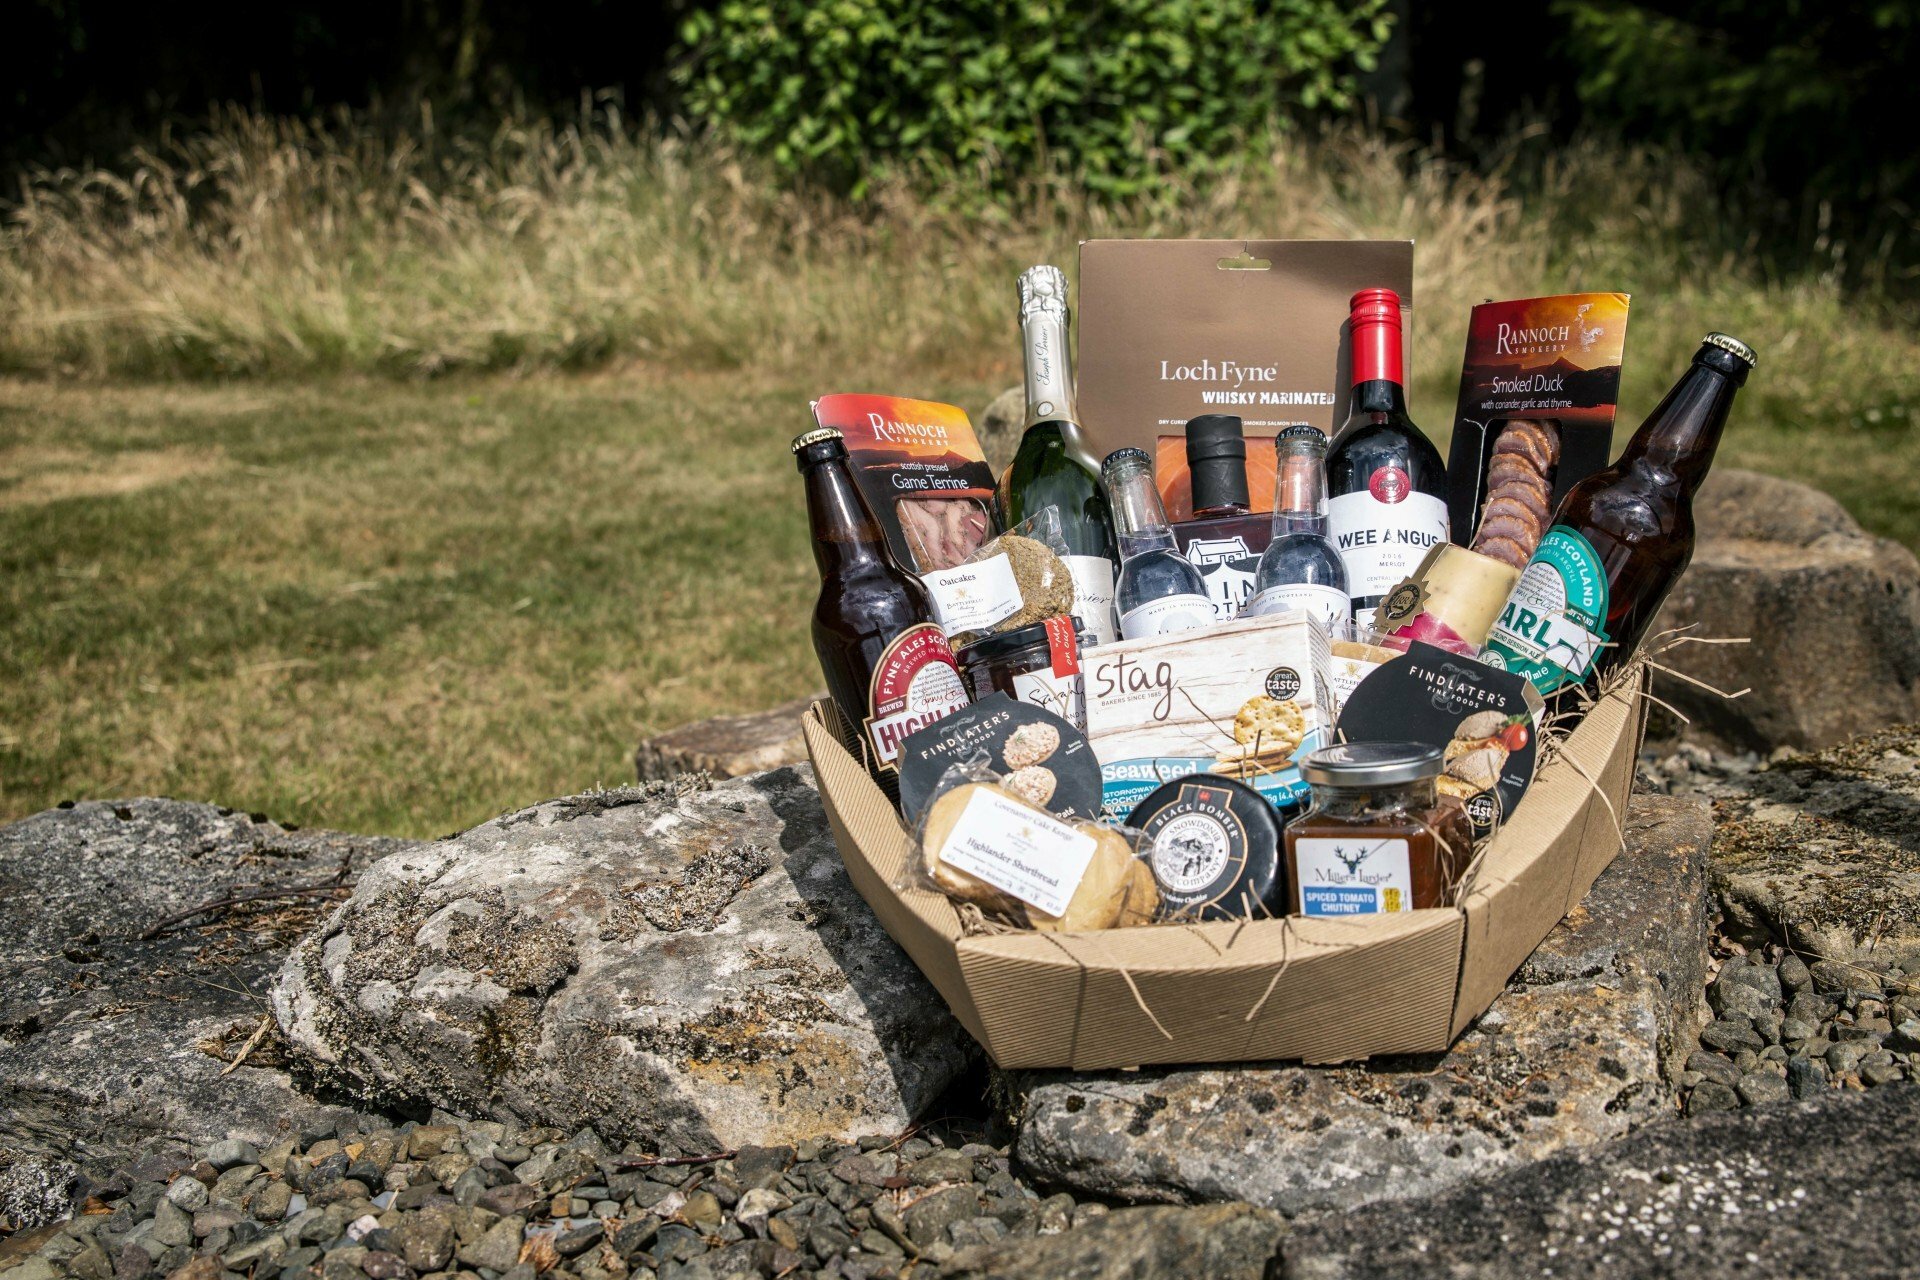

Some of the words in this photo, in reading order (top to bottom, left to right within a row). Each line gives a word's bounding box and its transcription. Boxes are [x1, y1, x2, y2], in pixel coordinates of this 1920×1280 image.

[1496, 323, 1570, 354] RANNOCH
[1515, 344, 1566, 354] SMOKERY
[1160, 360, 1218, 380] Loch
[1220, 361, 1278, 388] Fyne
[1492, 375, 1532, 394] Smoked
[1534, 374, 1564, 392] Duck
[1202, 392, 1256, 405] WHISKY
[1260, 392, 1336, 405] MARINATED
[1481, 400, 1494, 409] with
[1520, 398, 1536, 411] garlic
[1537, 398, 1550, 408] and
[1550, 398, 1572, 411] thyme
[867, 413, 948, 442] RANNOCH
[896, 436, 949, 446] SMOKERY
[900, 462, 924, 470] scottish
[925, 463, 949, 472] pressed
[892, 474, 928, 489] Game
[926, 474, 969, 490] Terrine
[1338, 529, 1377, 549] WEE
[1383, 528, 1438, 548] ANGUS
[1560, 557, 1576, 583] ARGYLL
[1560, 541, 1593, 607] SCOTLAND
[940, 574, 976, 586] Oatcakes
[1224, 580, 1254, 599] IN
[1498, 602, 1552, 649] ARL
[1507, 639, 1528, 653] SESSION
[884, 660, 901, 694] FYNE
[900, 637, 926, 660] ALES
[903, 651, 926, 674] BREWED
[1267, 679, 1300, 690] taste
[1409, 666, 1506, 707] FINDLATER'S
[1102, 697, 1126, 706] BAKERS
[1427, 685, 1447, 697] FINE
[1451, 694, 1480, 709] FOODS
[878, 701, 904, 714] BREWED
[921, 711, 1010, 760] FINDLATER'S
[948, 745, 966, 757] FINE
[970, 731, 995, 746] FOODS
[1102, 762, 1197, 780] Seaweed
[1104, 785, 1154, 798] STORNOWAY
[1104, 793, 1148, 805] COCKTAI
[1057, 806, 1076, 818] Paté
[1155, 802, 1193, 826] BLACK
[1199, 802, 1238, 838] BOMBER
[1034, 817, 1051, 831] Cake
[967, 837, 1011, 863] Highlander
[1012, 859, 1059, 887] Shortbread
[1306, 892, 1337, 902] SPICED
[1339, 893, 1374, 903] TOMATO
[1321, 903, 1360, 913] CHUTNEY
